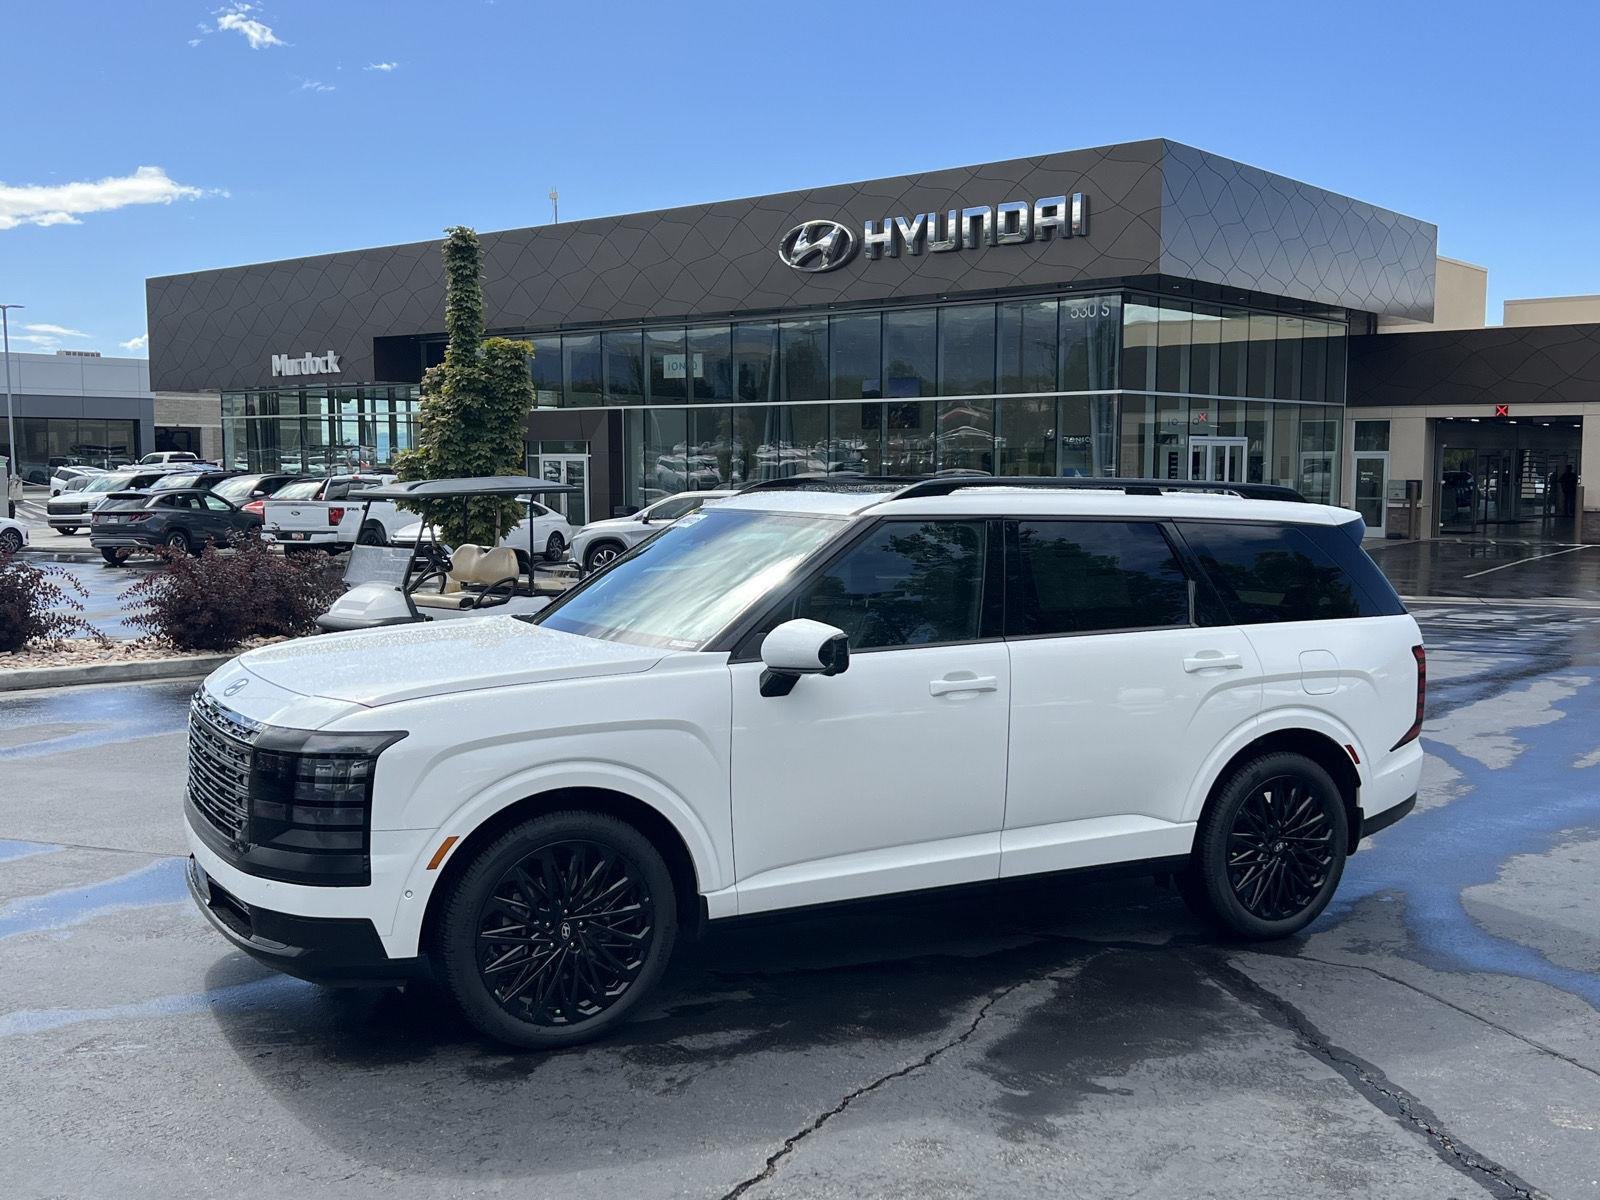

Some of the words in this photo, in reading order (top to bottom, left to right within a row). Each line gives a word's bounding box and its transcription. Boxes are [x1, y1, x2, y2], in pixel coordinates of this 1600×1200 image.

[864, 192, 1087, 260] HYUNDAI
[1101, 301, 1110, 317] S
[271, 350, 341, 377] Murdock
